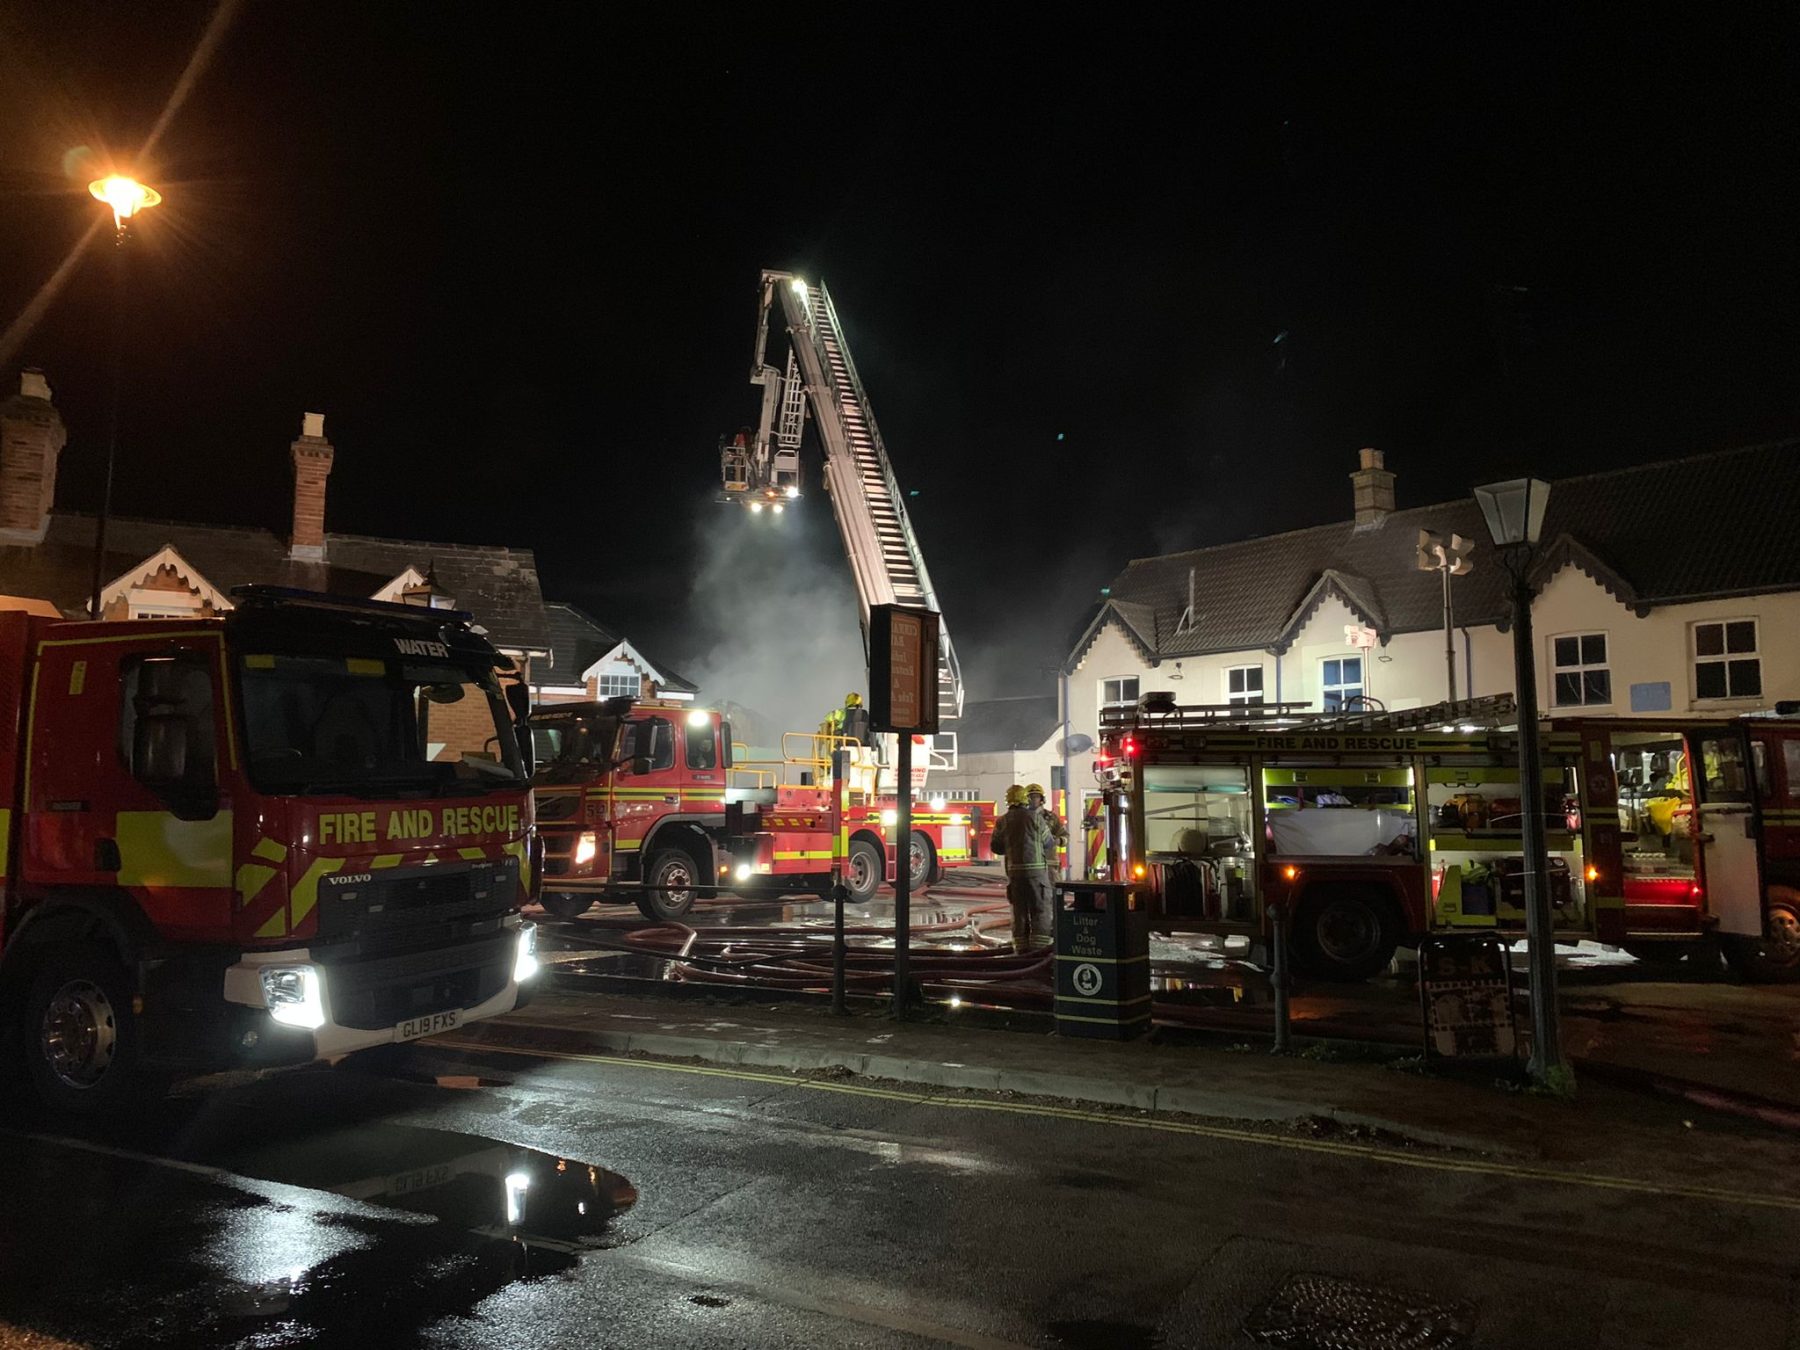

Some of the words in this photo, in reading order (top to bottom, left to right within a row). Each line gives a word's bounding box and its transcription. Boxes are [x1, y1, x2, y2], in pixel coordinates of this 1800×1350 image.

[393, 638, 449, 658] WATER
[1257, 737, 1296, 749] FIRE
[1302, 738, 1339, 749] AND
[1345, 738, 1417, 750] RESCUE
[319, 812, 377, 845] FIRE
[386, 809, 434, 840] AND
[442, 805, 519, 836] RESCUE
[328, 873, 372, 886] VOLVO
[1073, 915, 1098, 927] Litter
[1076, 933, 1097, 946] Dog
[1071, 945, 1103, 956] Waste
[403, 1017, 431, 1038] GL19
[433, 1011, 456, 1030] FXS
